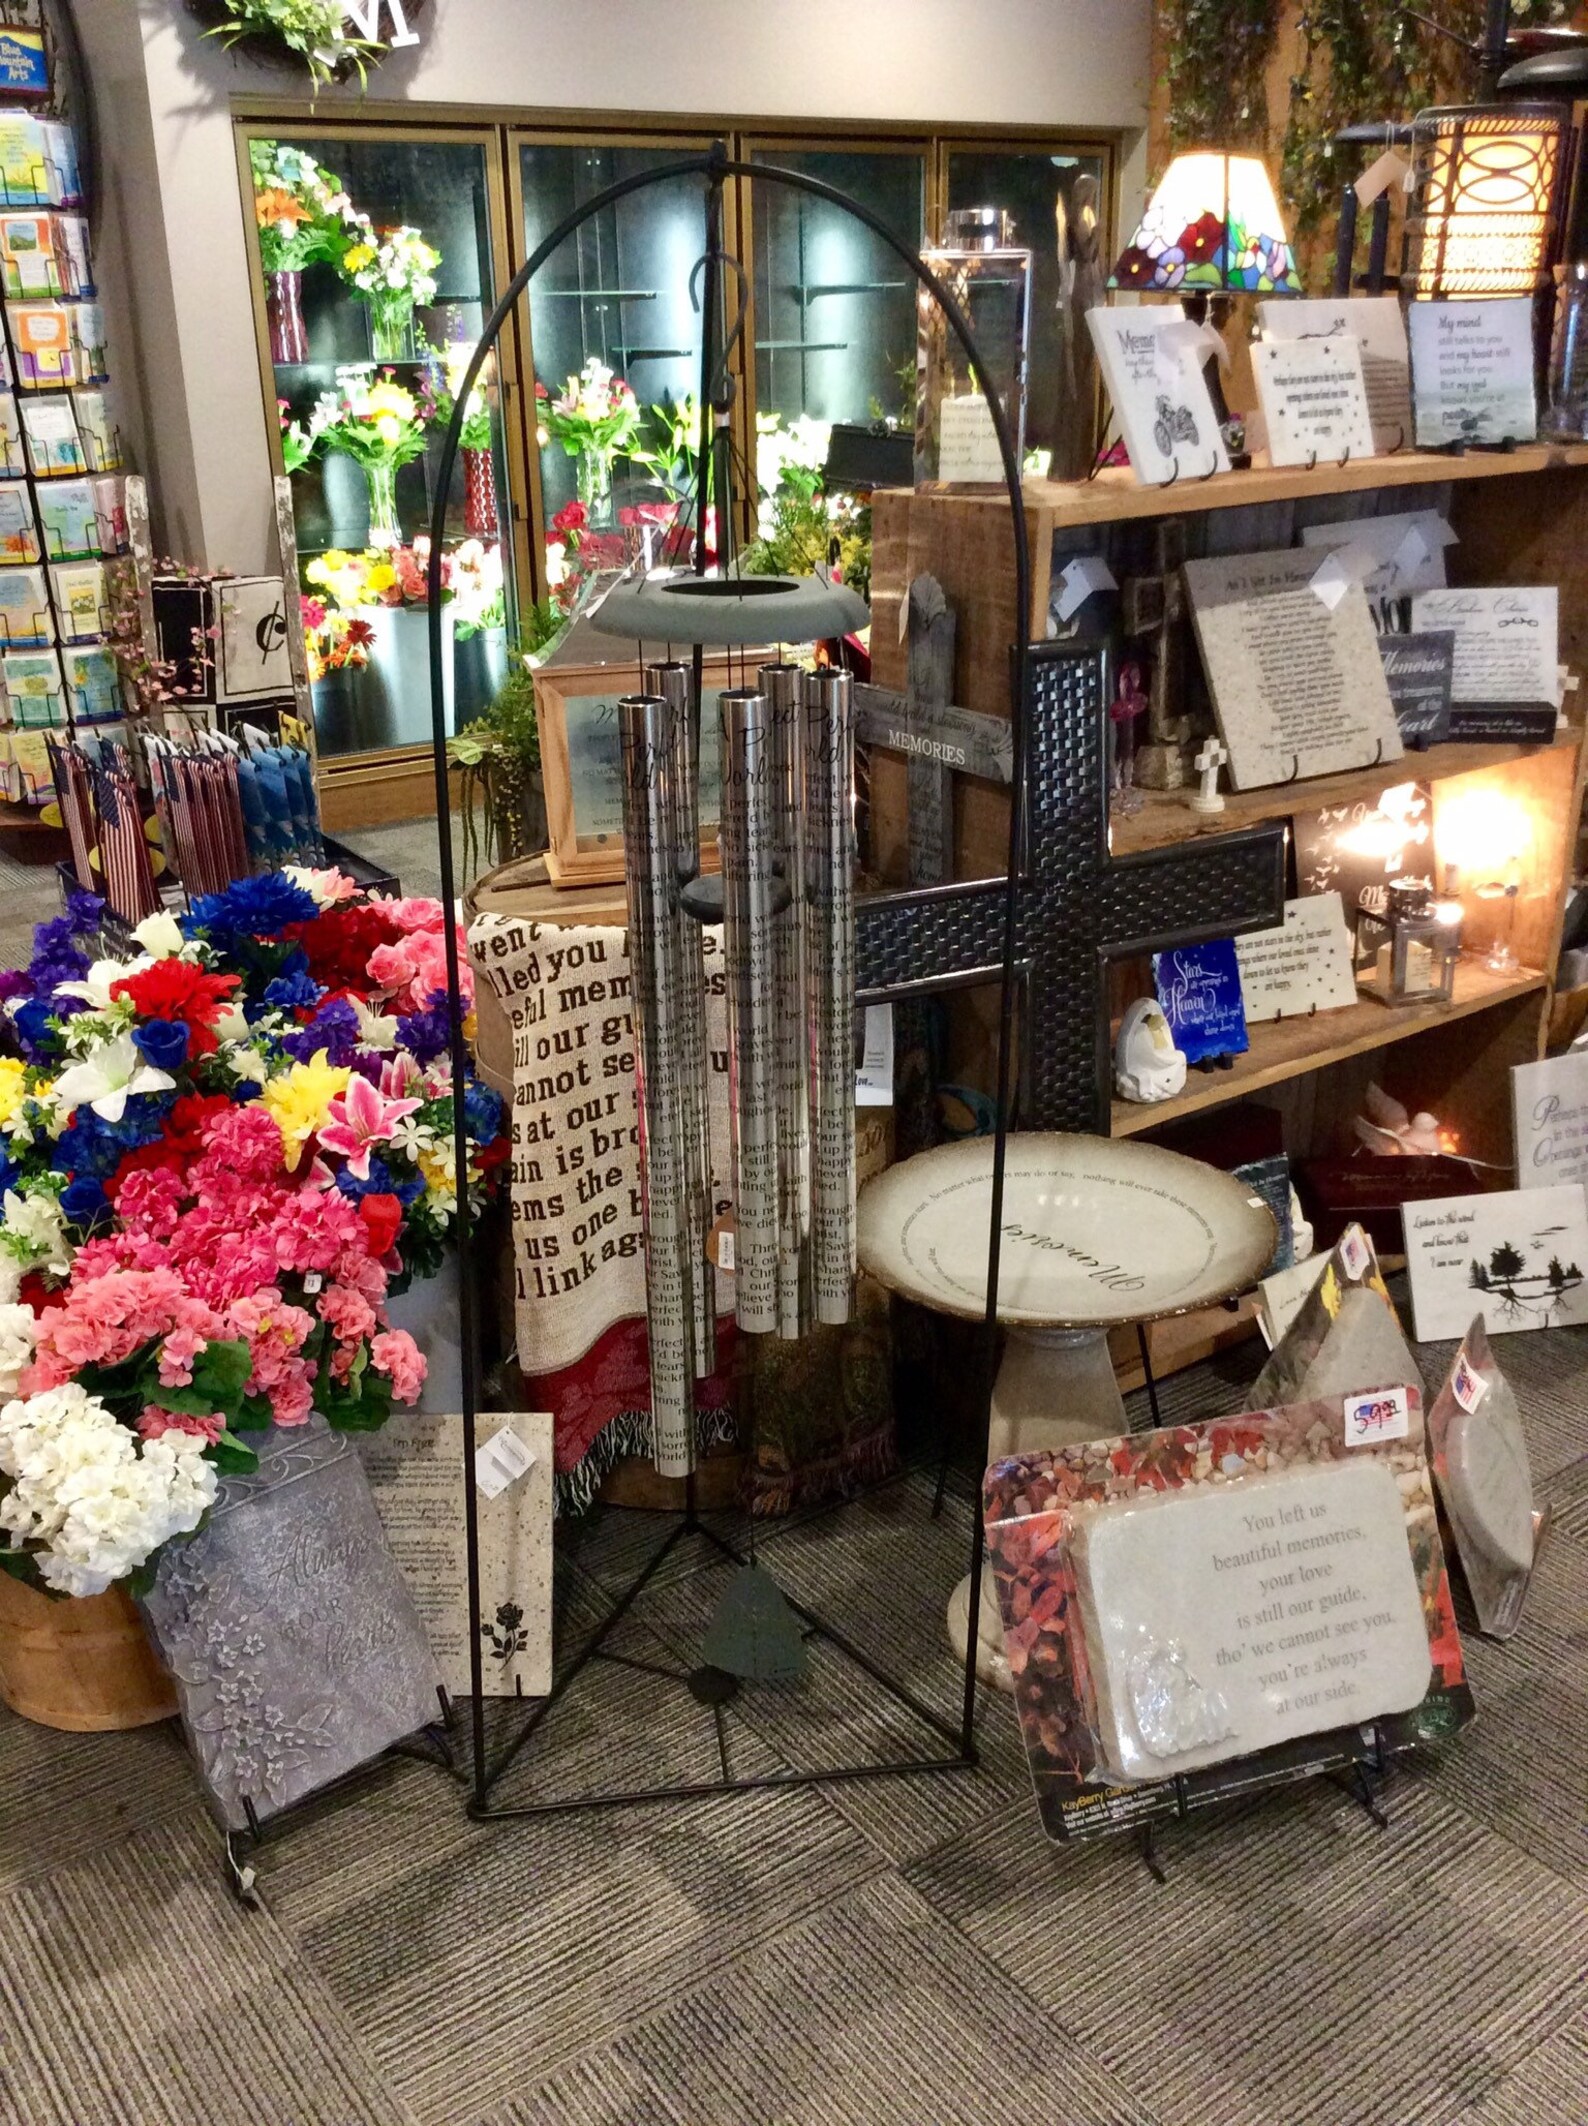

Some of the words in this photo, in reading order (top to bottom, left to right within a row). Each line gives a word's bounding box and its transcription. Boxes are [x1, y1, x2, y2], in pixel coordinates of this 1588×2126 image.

[888, 728, 966, 767] MEMORIES
[470, 922, 542, 963] went
[487, 953, 541, 999] lled
[546, 939, 607, 983] you
[1163, 977, 1216, 1028] Heaven
[514, 1034, 530, 1068] ill
[537, 1022, 590, 1060] our
[515, 1059, 592, 1106] annot
[527, 1111, 555, 1144] at
[566, 1092, 620, 1130] our
[511, 1154, 543, 1184] ain
[555, 1145, 585, 1176] is
[511, 1193, 565, 1222] ems
[576, 1165, 623, 1204] the
[525, 1236, 560, 1261] us
[572, 1203, 618, 1246] one
[736, 1292, 772, 1303] elieve
[1242, 1514, 1276, 1533] You
[1279, 1504, 1305, 1527] left
[1309, 1502, 1327, 1518] us
[1212, 1540, 1283, 1572] beautiful
[1287, 1525, 1367, 1555] memories,
[1259, 1572, 1296, 1599] your
[1299, 1563, 1333, 1584] love
[1237, 1612, 1251, 1631] is
[1255, 1602, 1284, 1627] still
[1288, 1598, 1315, 1618] our
[1318, 1584, 1367, 1615] guide,
[1216, 1643, 1246, 1667] tho'
[1252, 1641, 1275, 1659] we
[1278, 1624, 1332, 1652] cannot
[1334, 1619, 1360, 1638] see
[1258, 1663, 1309, 1693] you're
[1314, 1646, 1368, 1670] always
[1276, 1700, 1291, 1715] at
[1294, 1691, 1320, 1708] our
[1061, 1793, 1104, 1812] KayBerry
